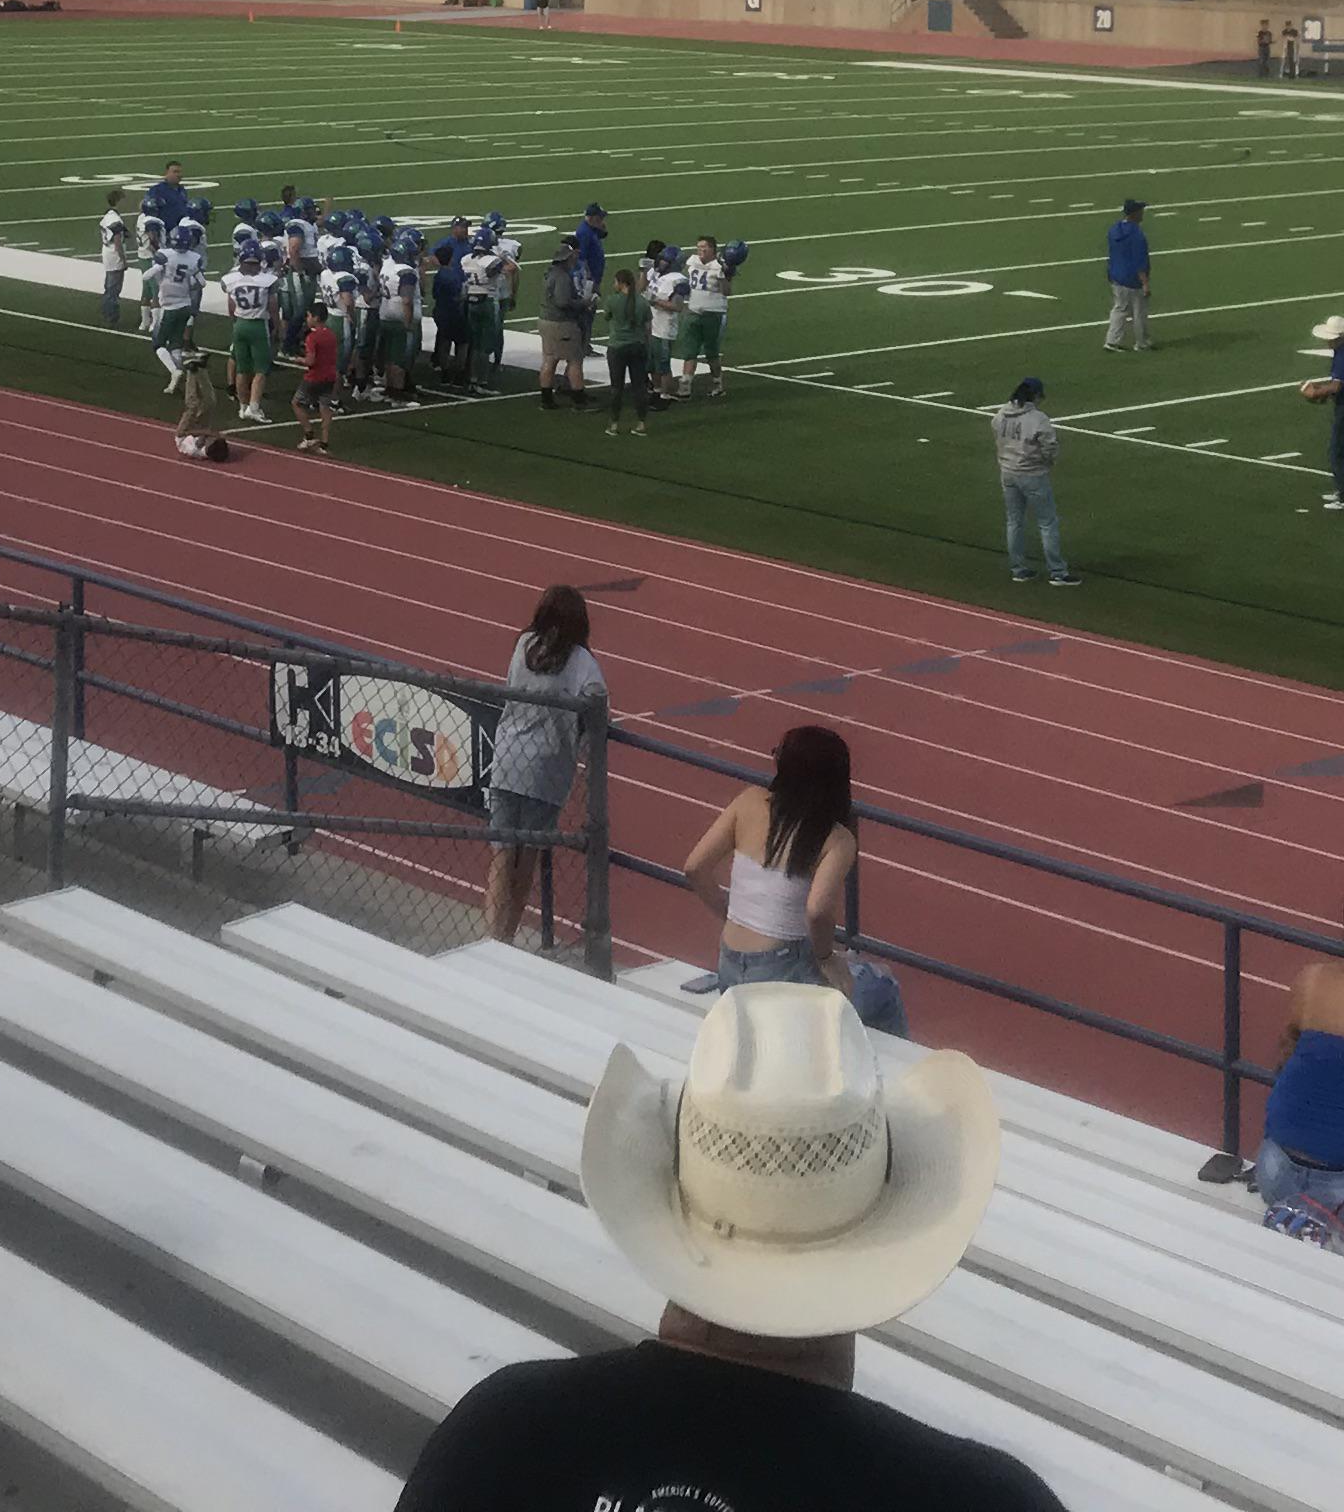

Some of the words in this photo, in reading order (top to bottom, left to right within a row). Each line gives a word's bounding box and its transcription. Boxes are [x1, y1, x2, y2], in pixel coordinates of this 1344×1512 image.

[1096, 9, 1112, 29] 20
[173, 263, 189, 283] 5
[690, 269, 709, 291] 64
[775, 266, 994, 296] 30
